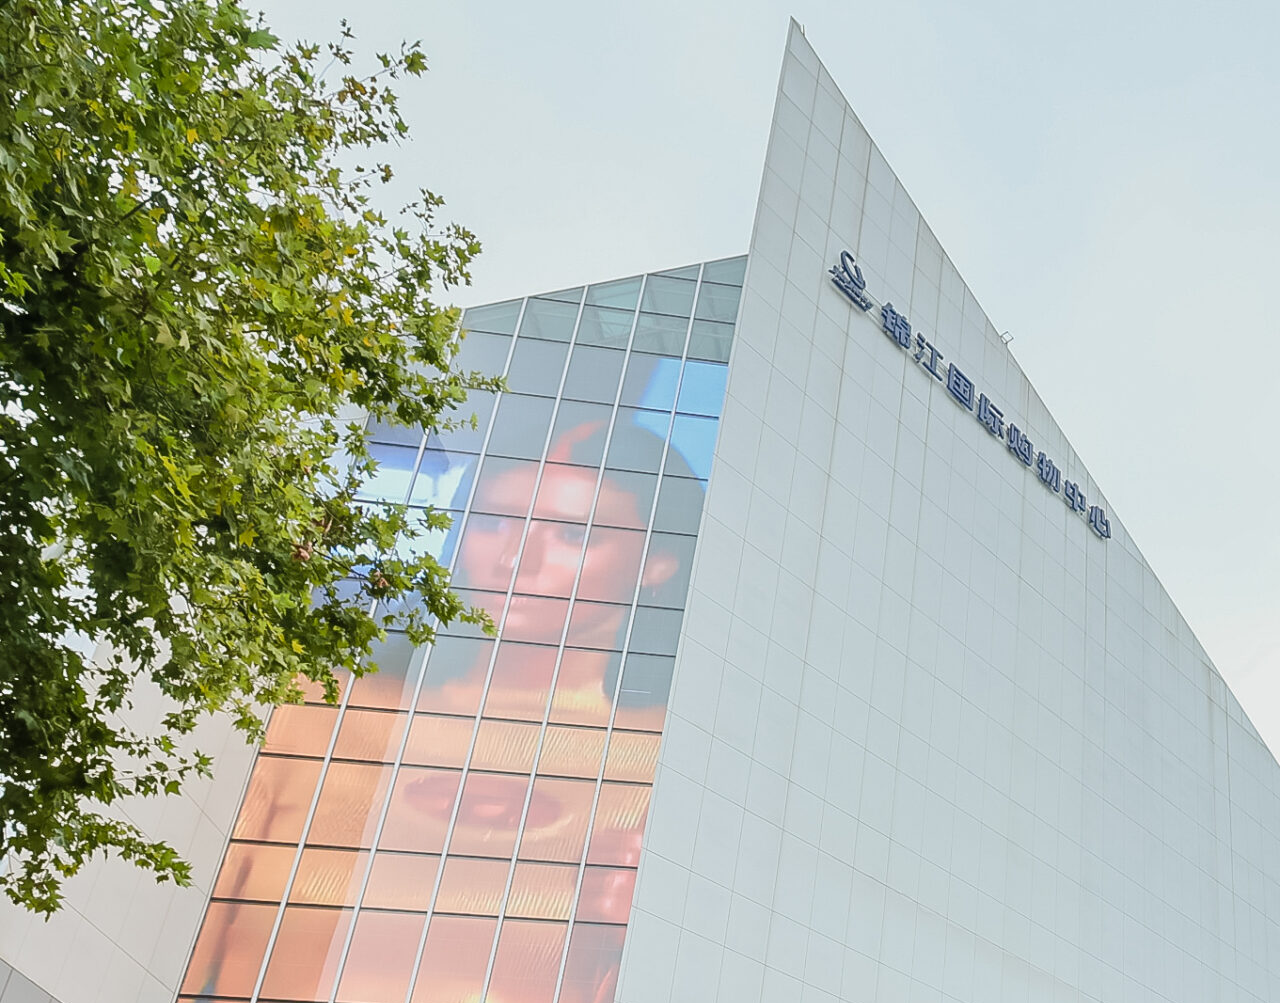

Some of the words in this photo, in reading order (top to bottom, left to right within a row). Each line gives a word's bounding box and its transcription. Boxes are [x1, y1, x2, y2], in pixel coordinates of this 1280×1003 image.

[881, 301, 1111, 540] 锦江国际购物中心
